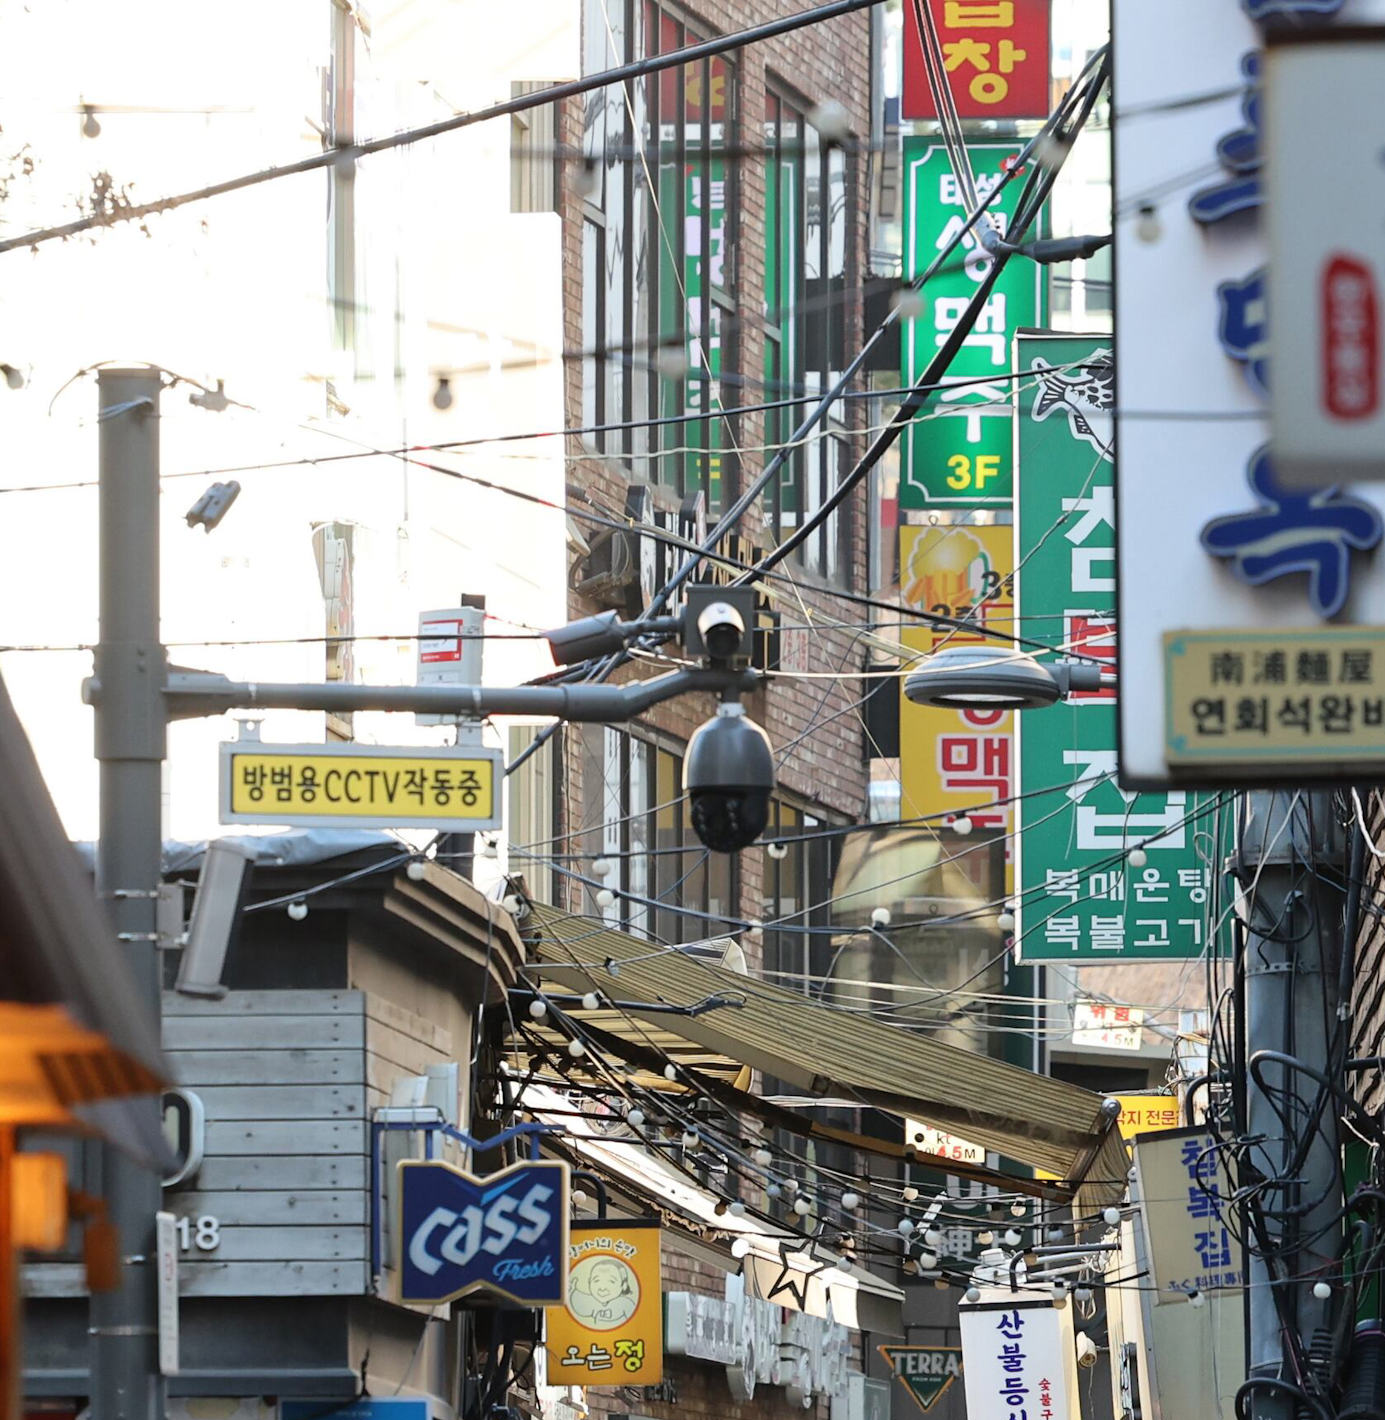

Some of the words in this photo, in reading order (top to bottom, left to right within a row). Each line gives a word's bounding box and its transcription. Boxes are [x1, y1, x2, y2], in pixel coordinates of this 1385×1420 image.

[946, 454, 1001, 489] 3F
[243, 763, 482, 807] 방범용CCTV작동중
[1044, 866, 1211, 905] 복매운탕
[177, 1215, 220, 1252] 18
[410, 1183, 555, 1275] Cass
[493, 1258, 554, 1281] Fresh
[560, 1338, 644, 1373] 오는정
[891, 1352, 960, 1375] TERRA
